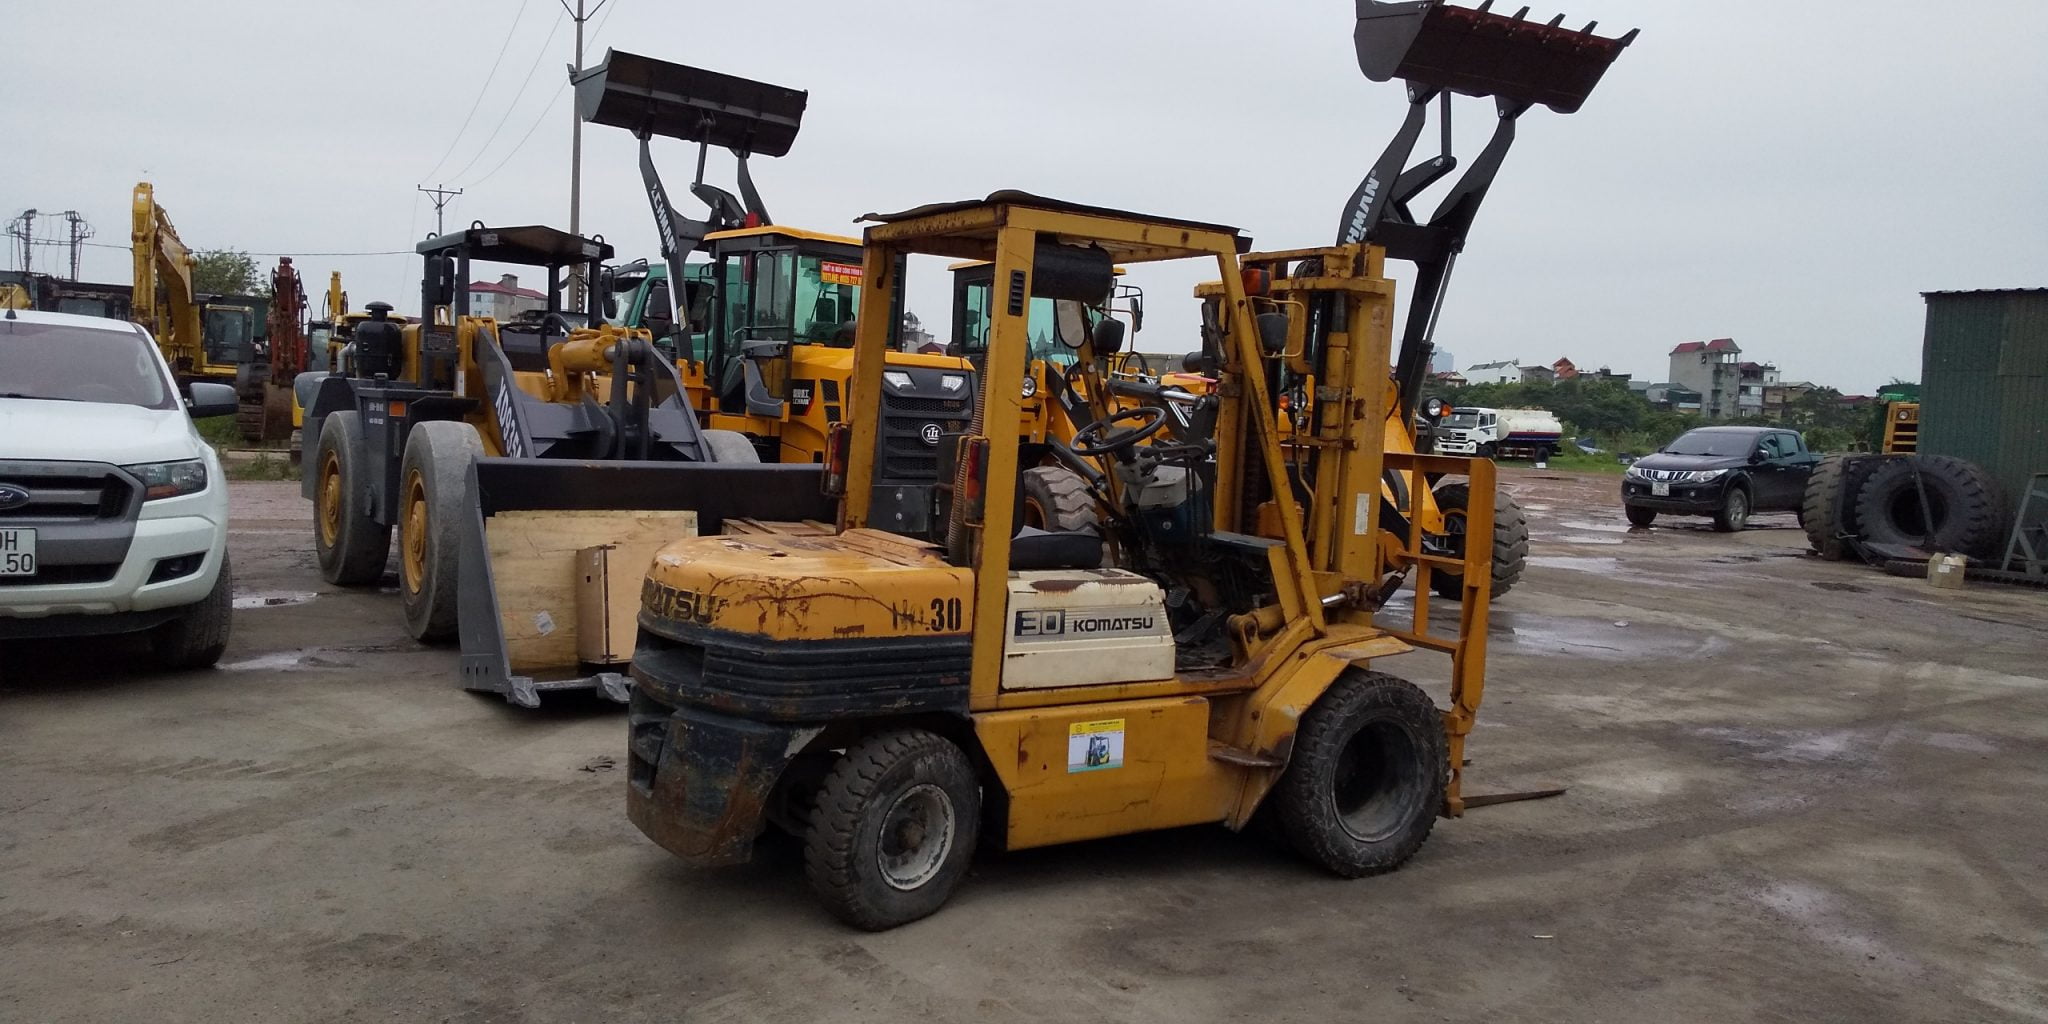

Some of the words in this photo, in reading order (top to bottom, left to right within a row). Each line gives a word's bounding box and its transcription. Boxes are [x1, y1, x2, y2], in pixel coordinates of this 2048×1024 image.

[0, 530, 18, 551] H
[1021, 611, 1061, 636] 30
[1073, 616, 1154, 633] KOMATSU
